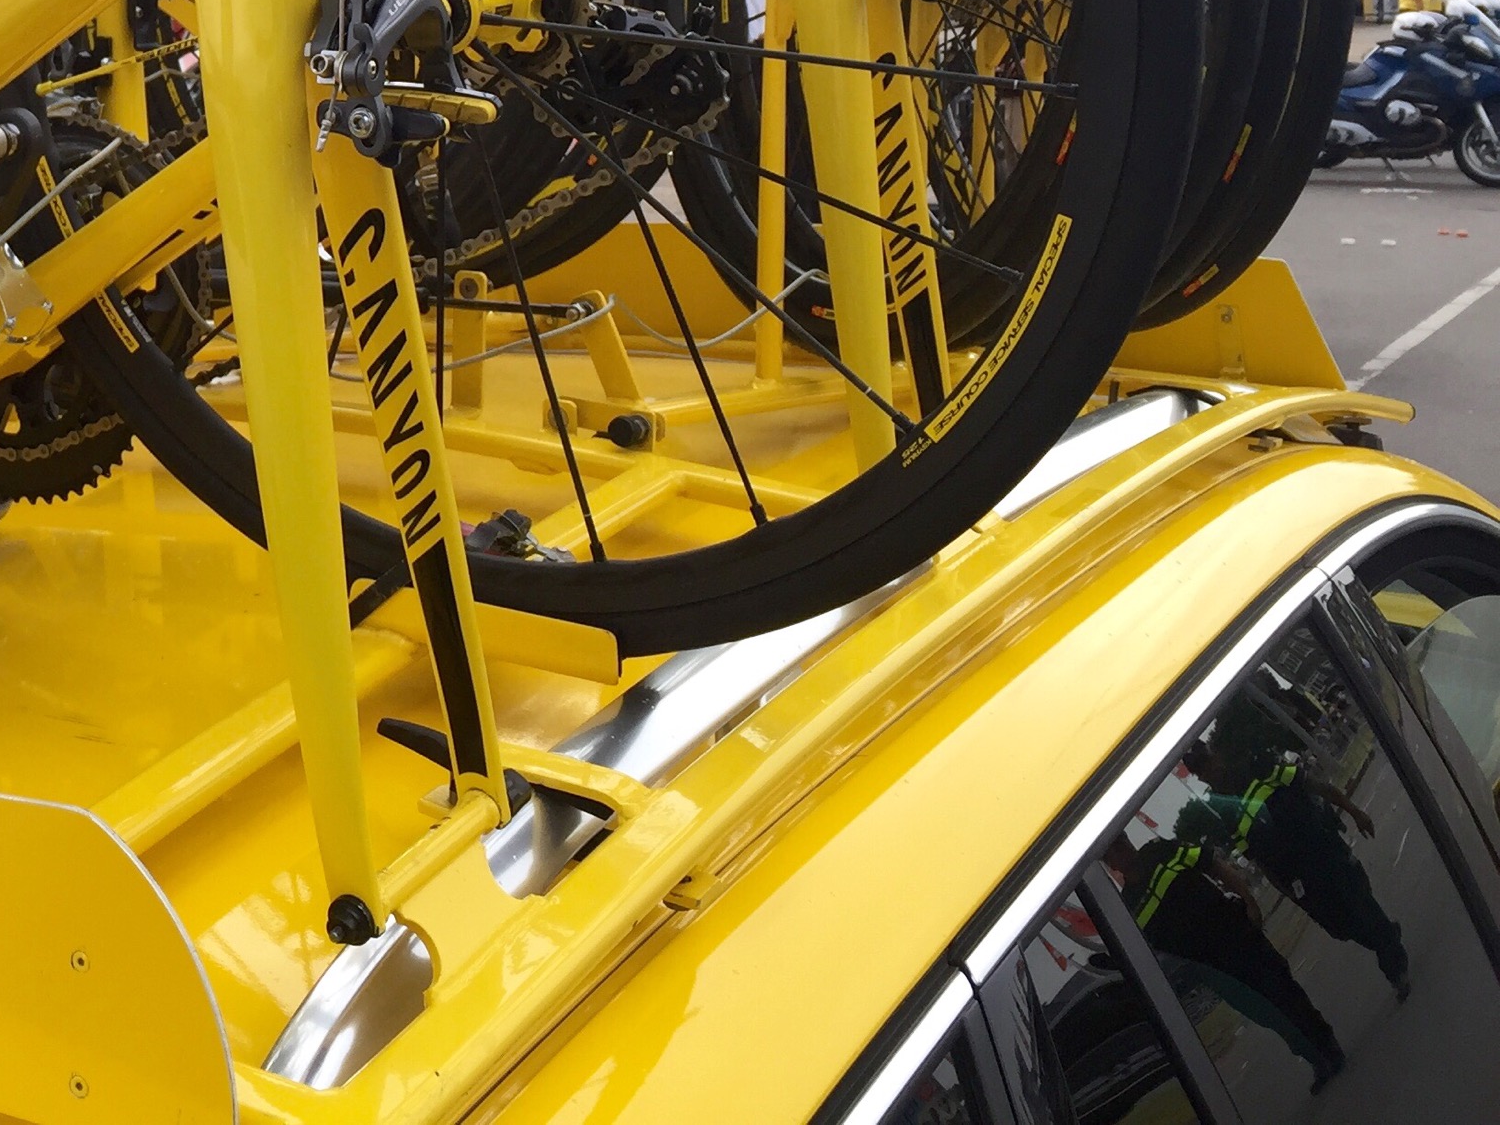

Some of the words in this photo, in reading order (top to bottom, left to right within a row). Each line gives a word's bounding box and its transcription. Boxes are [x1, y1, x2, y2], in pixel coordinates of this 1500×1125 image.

[1031, 218, 1068, 296] SPECIAL
[988, 299, 1036, 373] SERVICE
[338, 207, 442, 550] CANYON
[933, 371, 989, 435] COURSE
